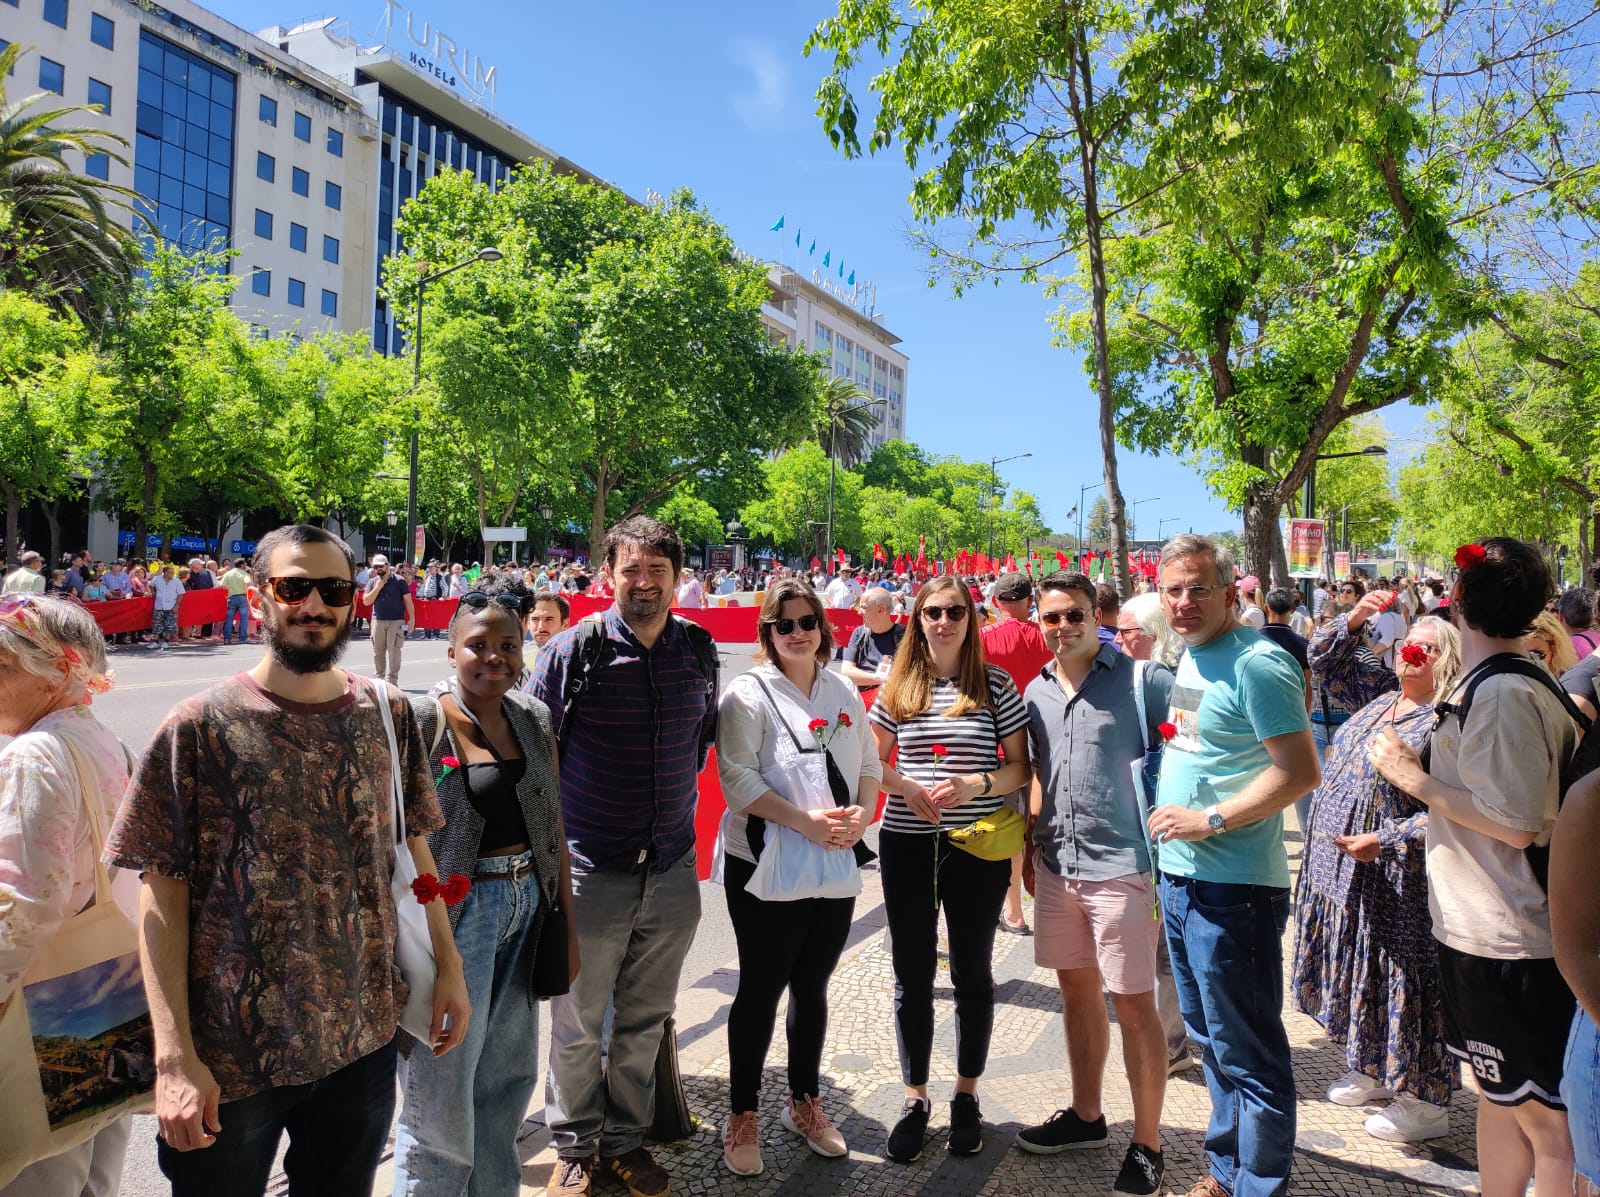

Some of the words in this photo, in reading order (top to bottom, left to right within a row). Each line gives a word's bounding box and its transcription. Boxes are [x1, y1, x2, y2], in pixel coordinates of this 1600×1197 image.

[385, 0, 497, 98] TURIM
[410, 51, 456, 87] HOTELS
[1473, 1055, 1502, 1083] 93
